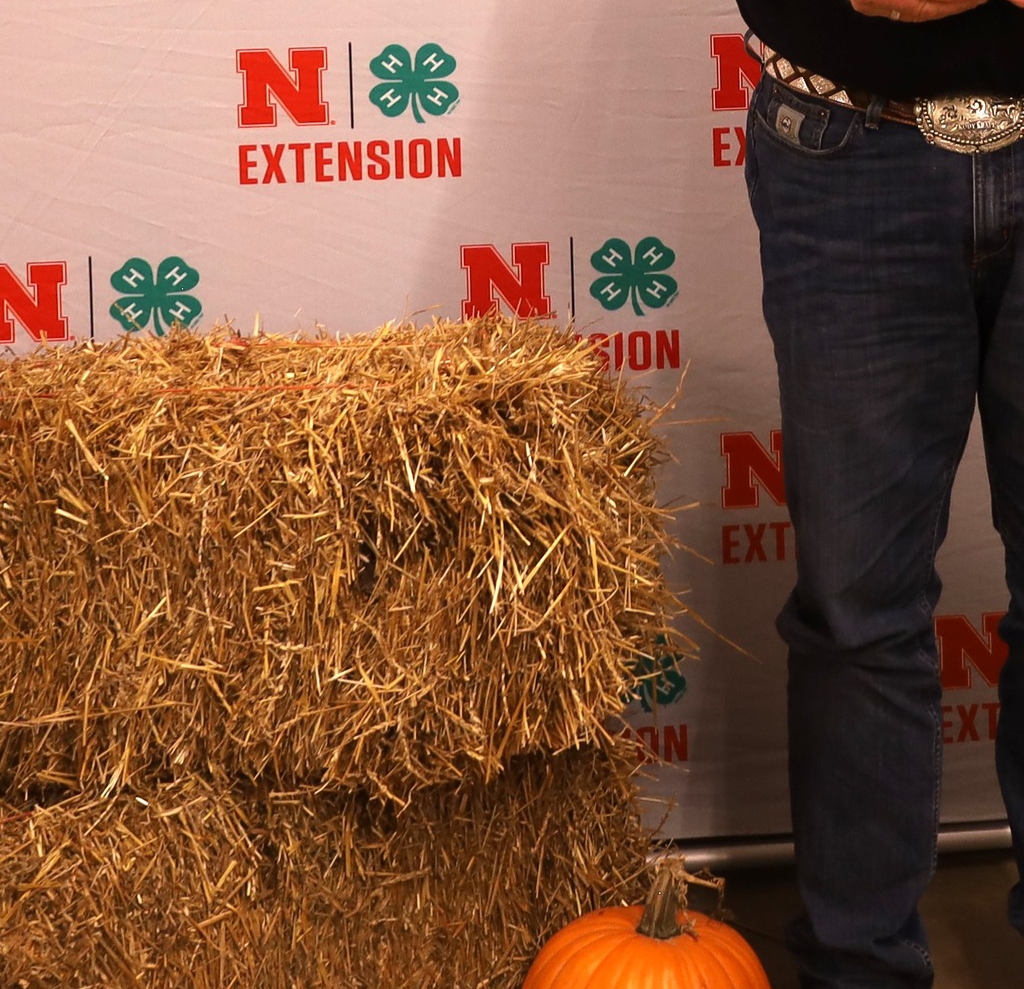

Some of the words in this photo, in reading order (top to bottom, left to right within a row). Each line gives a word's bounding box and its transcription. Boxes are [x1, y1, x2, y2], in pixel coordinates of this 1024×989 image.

[236, 47, 331, 129] N
[238, 137, 462, 185] EXTENSION
[460, 242, 550, 323] N
[720, 429, 788, 510] N
[932, 611, 1009, 691] N
